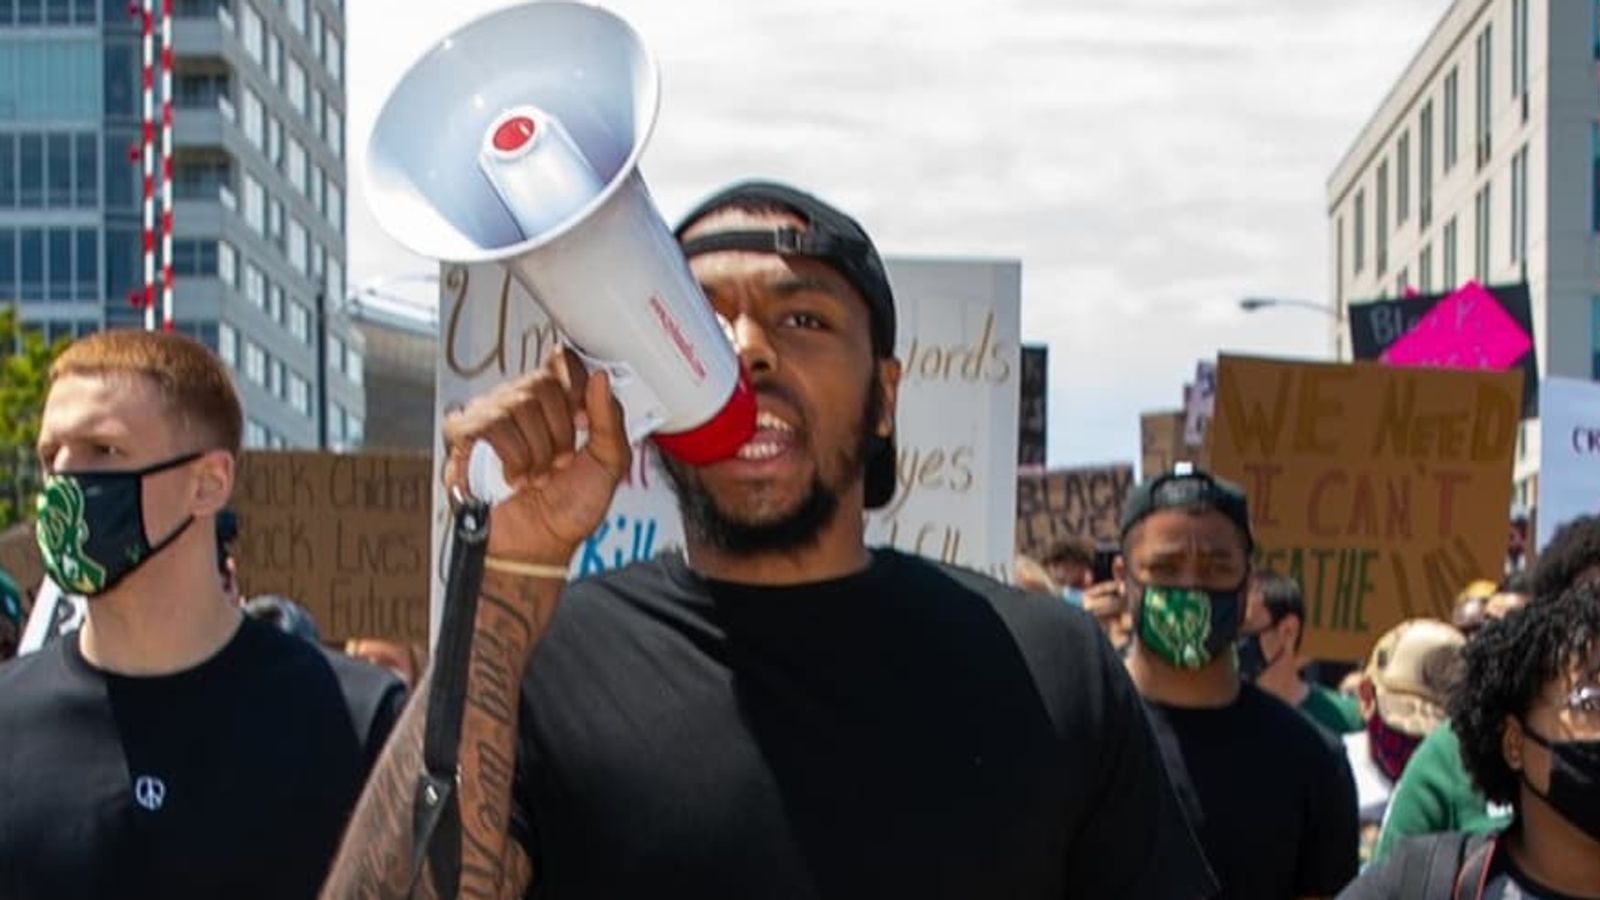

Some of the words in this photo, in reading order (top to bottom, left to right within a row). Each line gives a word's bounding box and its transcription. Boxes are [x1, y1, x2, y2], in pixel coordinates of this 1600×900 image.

[902, 311, 1010, 385] ords
[1221, 367, 1352, 458] WE
[882, 446, 974, 525] yes
[1017, 466, 1133, 518] BLACK
[1244, 463, 1284, 527] I
[1308, 463, 1471, 539] CAN'T
[579, 517, 655, 578] Kill
